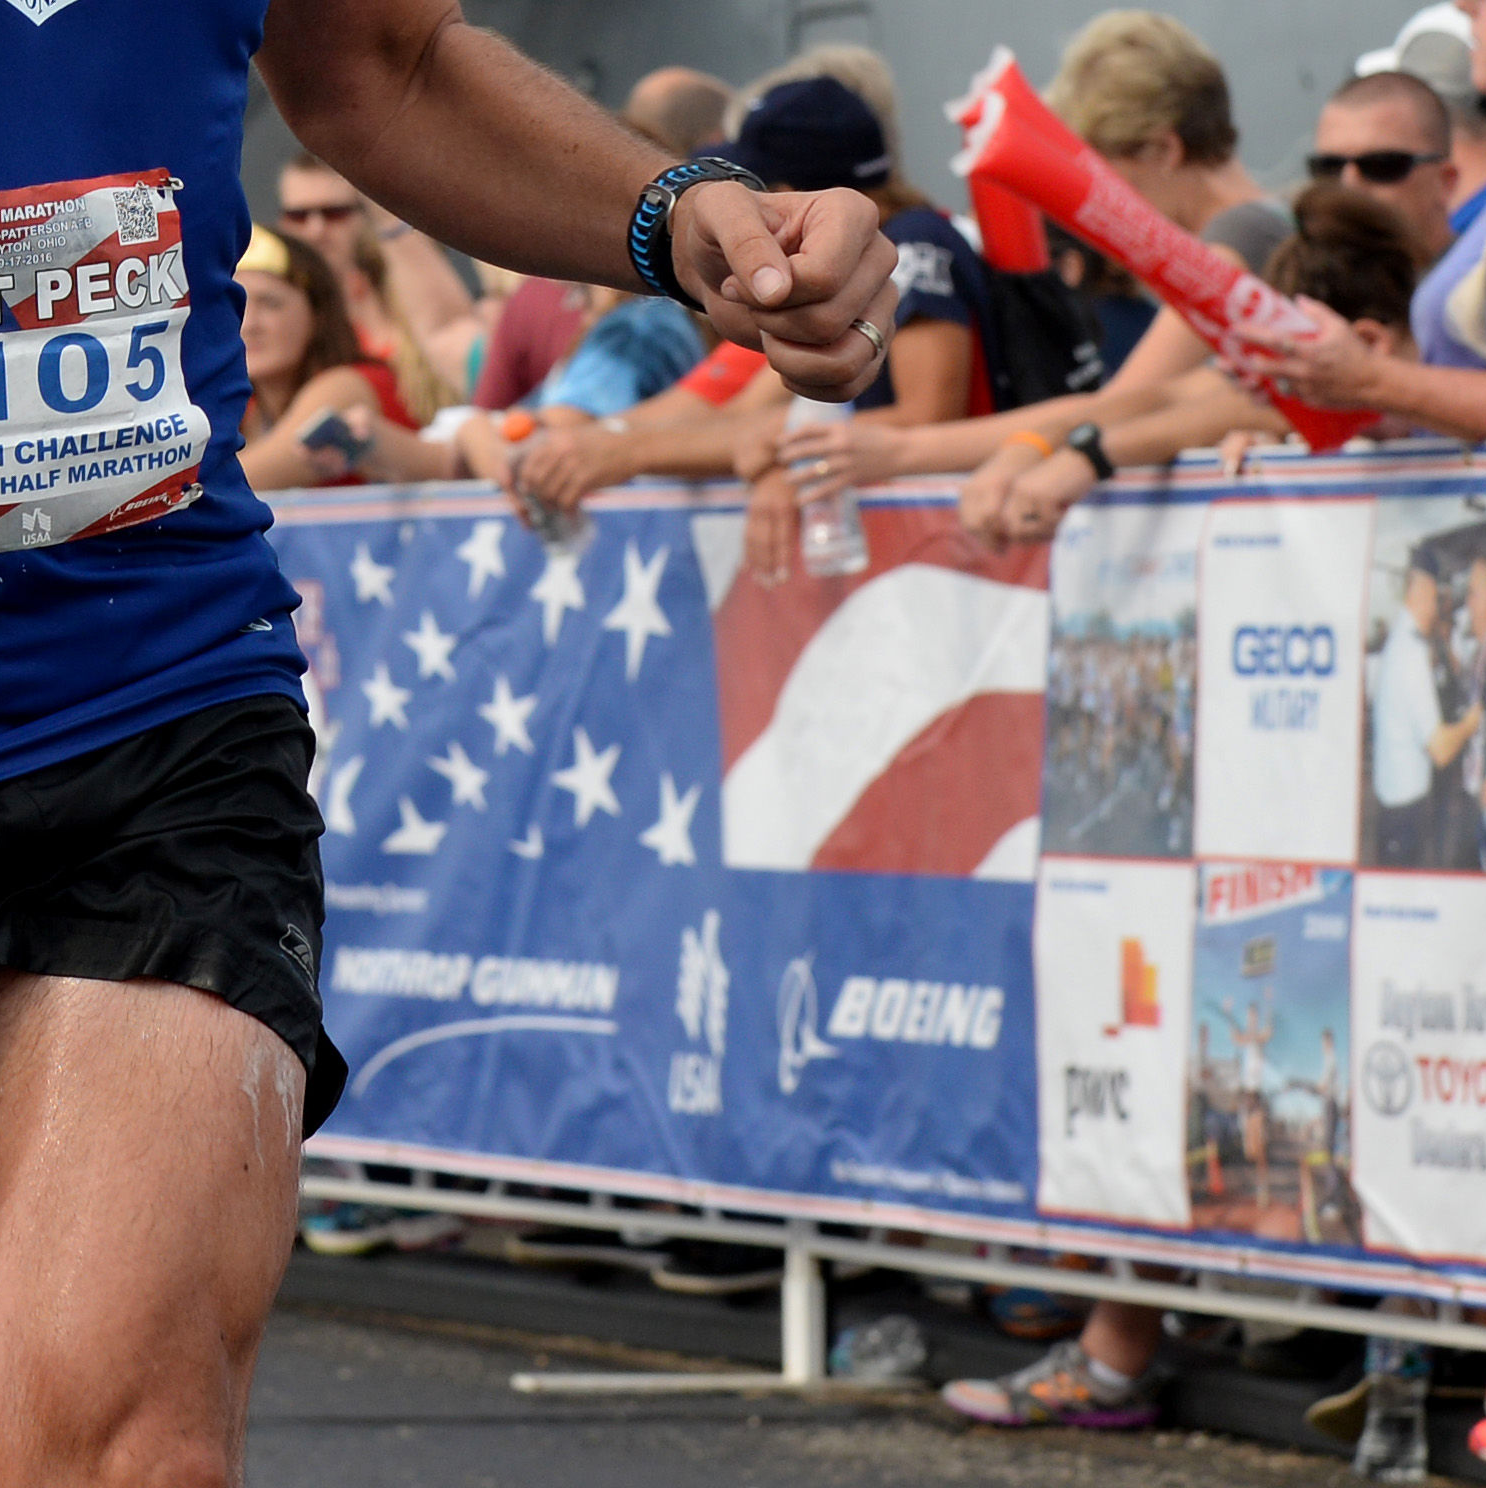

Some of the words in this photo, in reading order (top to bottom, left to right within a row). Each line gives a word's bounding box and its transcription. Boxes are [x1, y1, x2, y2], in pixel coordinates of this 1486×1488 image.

[0, 197, 87, 223] MARATHON
[37, 236, 66, 250] OHIO
[35, 250, 185, 320] PECK
[14, 413, 188, 465] CHALLENGE
[0, 468, 61, 495] HALF
[67, 442, 193, 484] MARATHON
[22, 531, 52, 546] USAA
[827, 975, 1005, 1050] BOEING
